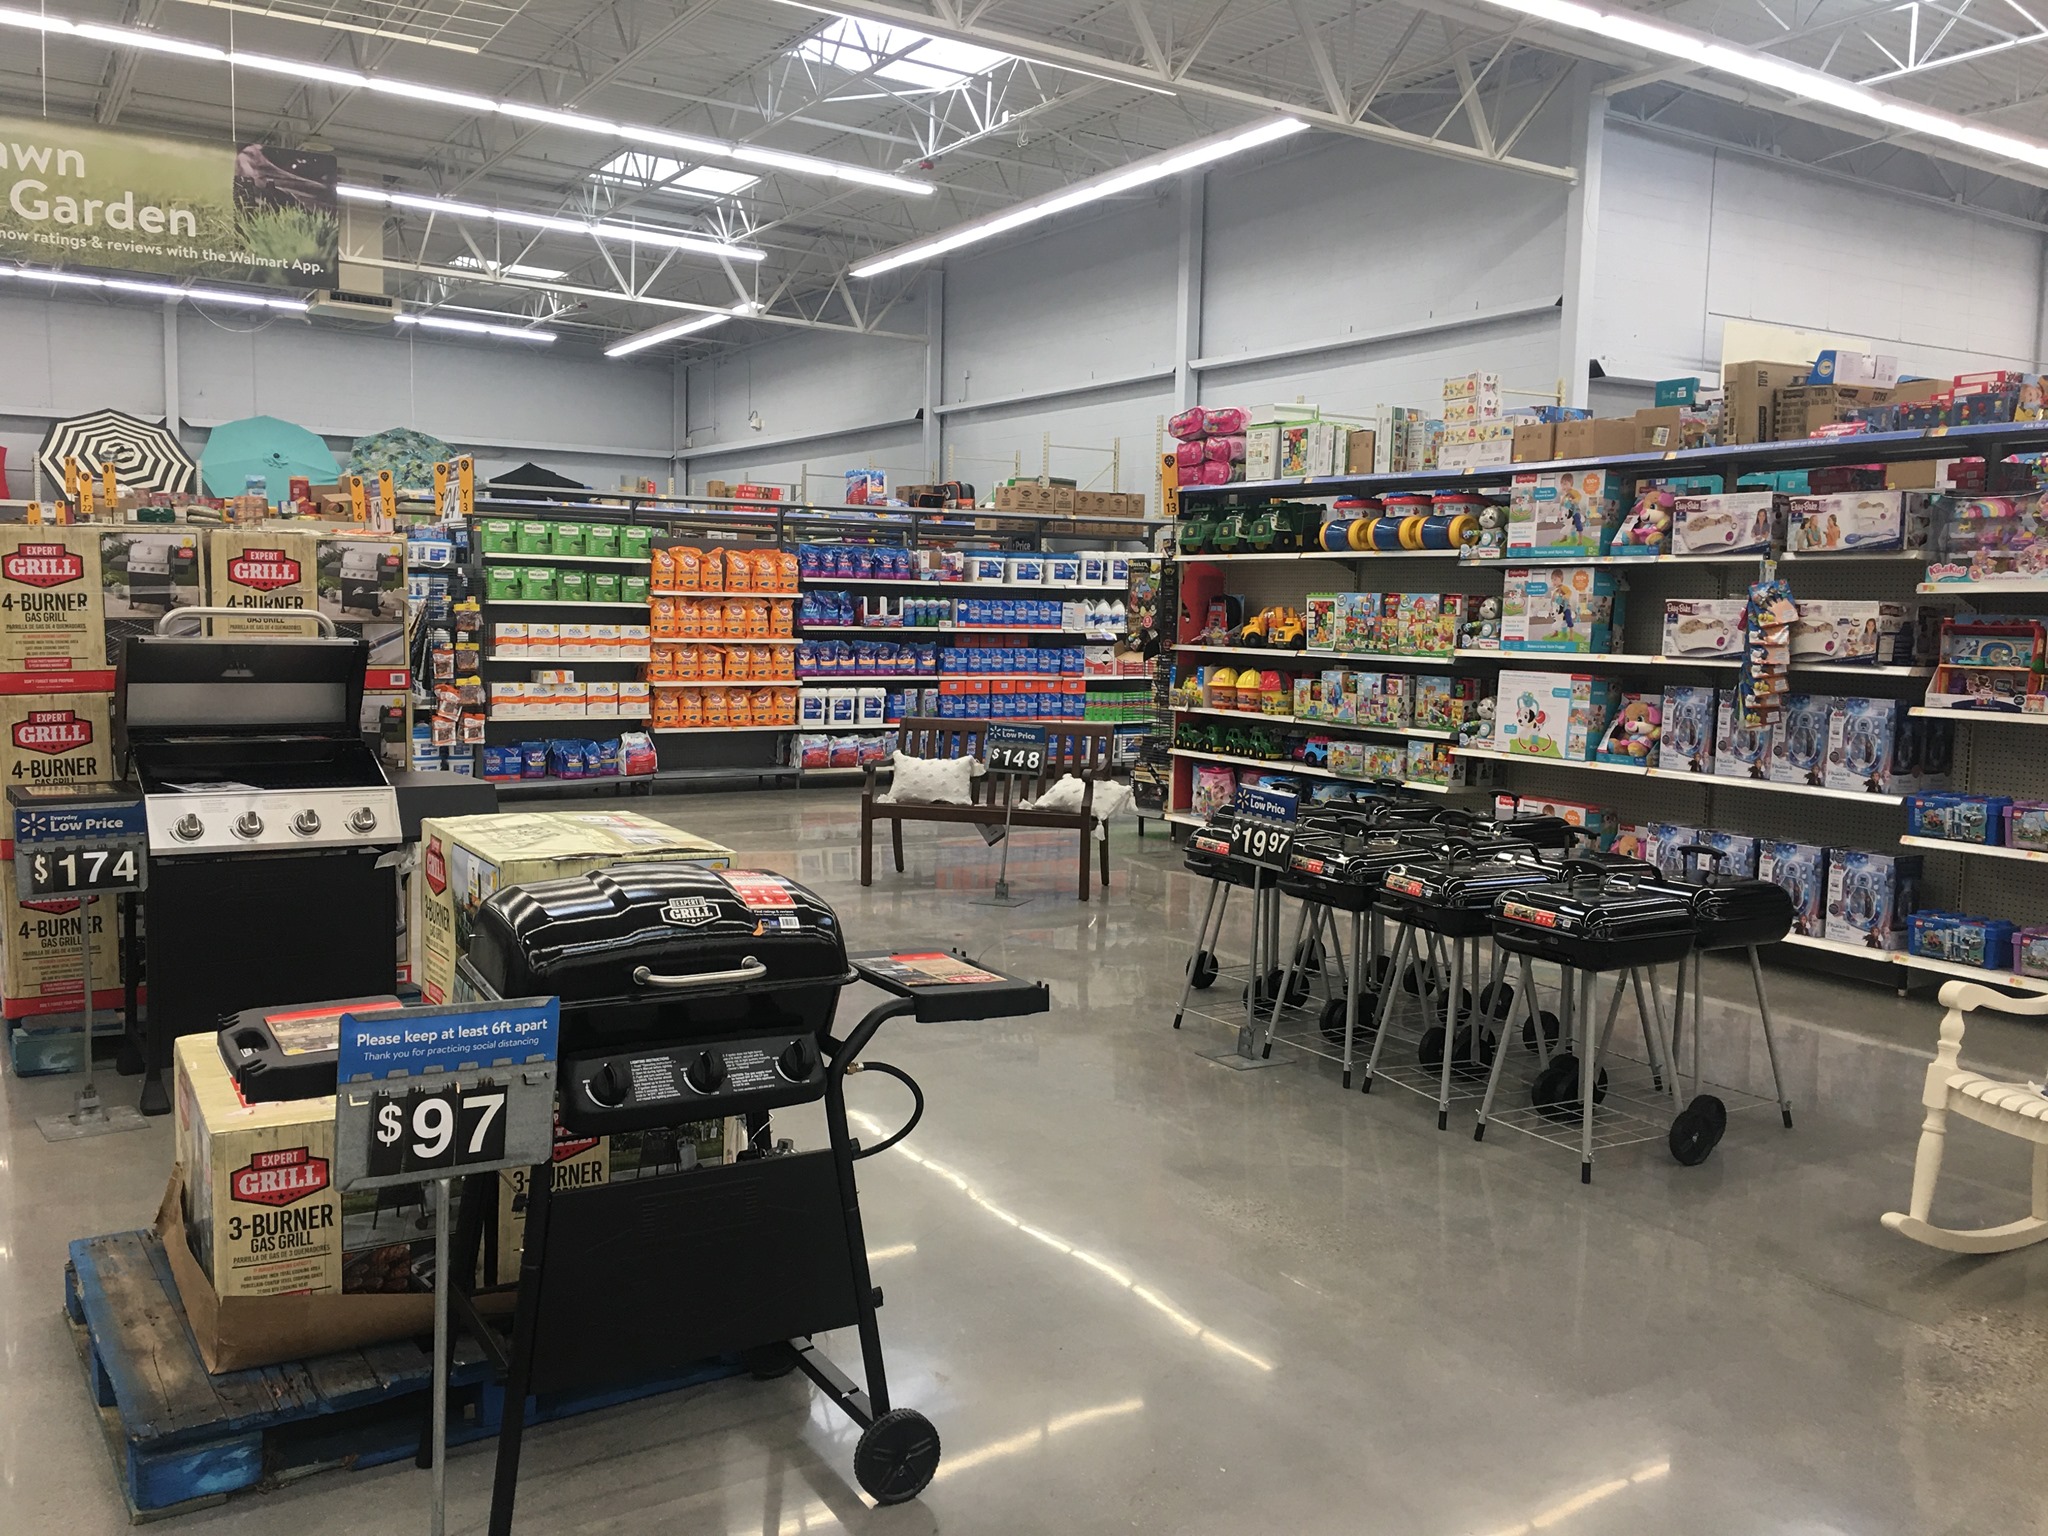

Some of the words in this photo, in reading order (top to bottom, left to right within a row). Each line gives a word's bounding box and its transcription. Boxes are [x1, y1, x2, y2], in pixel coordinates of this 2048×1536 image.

[10, 179, 196, 237] Garden
[34, 232, 86, 249] ratings
[91, 236, 103, 249] &
[107, 240, 162, 255] reviews
[167, 246, 198, 259] with
[202, 250, 226, 262] the
[230, 251, 288, 269] Walmart
[292, 259, 324, 275] App.
[1872, 392, 1888, 401] TOYS
[462, 490, 468, 498] Y
[464, 503, 468, 511] 3
[1166, 503, 1176, 512] 13
[27, 547, 56, 555] EXPERT
[251, 552, 277, 560] EXPERT
[8, 559, 76, 575] GRILL
[234, 563, 294, 579] GRILL
[2, 593, 88, 611] 4-BURNER
[25, 613, 41, 622] GAS
[44, 613, 67, 622] GRILL
[37, 713, 66, 722] EXPERT
[18, 725, 85, 743] GRILL
[992, 748, 1039, 768] $148
[12, 757, 97, 778] 4-BURNER
[1251, 799, 1265, 810] Low
[1267, 802, 1285, 815] Price
[50, 821, 82, 832] Low
[86, 818, 124, 830] Price
[35, 851, 138, 886] $174
[676, 899, 698, 908] EXPERT
[669, 907, 713, 919] GRILL
[42, 938, 57, 948] GAS
[59, 936, 82, 947] GRILL
[357, 1033, 400, 1047] Please
[405, 1029, 437, 1044] keep
[441, 1028, 454, 1039] at
[459, 1022, 488, 1038] least
[492, 1021, 511, 1035] 6ft
[515, 1018, 548, 1033] apart
[364, 1052, 391, 1061] Thank
[393, 1051, 409, 1061] you
[412, 1048, 425, 1057] for
[427, 1043, 470, 1057] practicing
[473, 1041, 496, 1050] social
[498, 1037, 539, 1050] distancing
[376, 1093, 505, 1159] $97
[262, 1151, 298, 1166] EXPERT
[239, 1165, 320, 1195] GRILL
[513, 1161, 602, 1193] 3-URNER
[229, 1204, 333, 1240] 3-BURNER
[251, 1236, 275, 1253] GAS
[279, 1231, 313, 1249] GRILL
[294, 1244, 330, 1255] QUEMADORES
